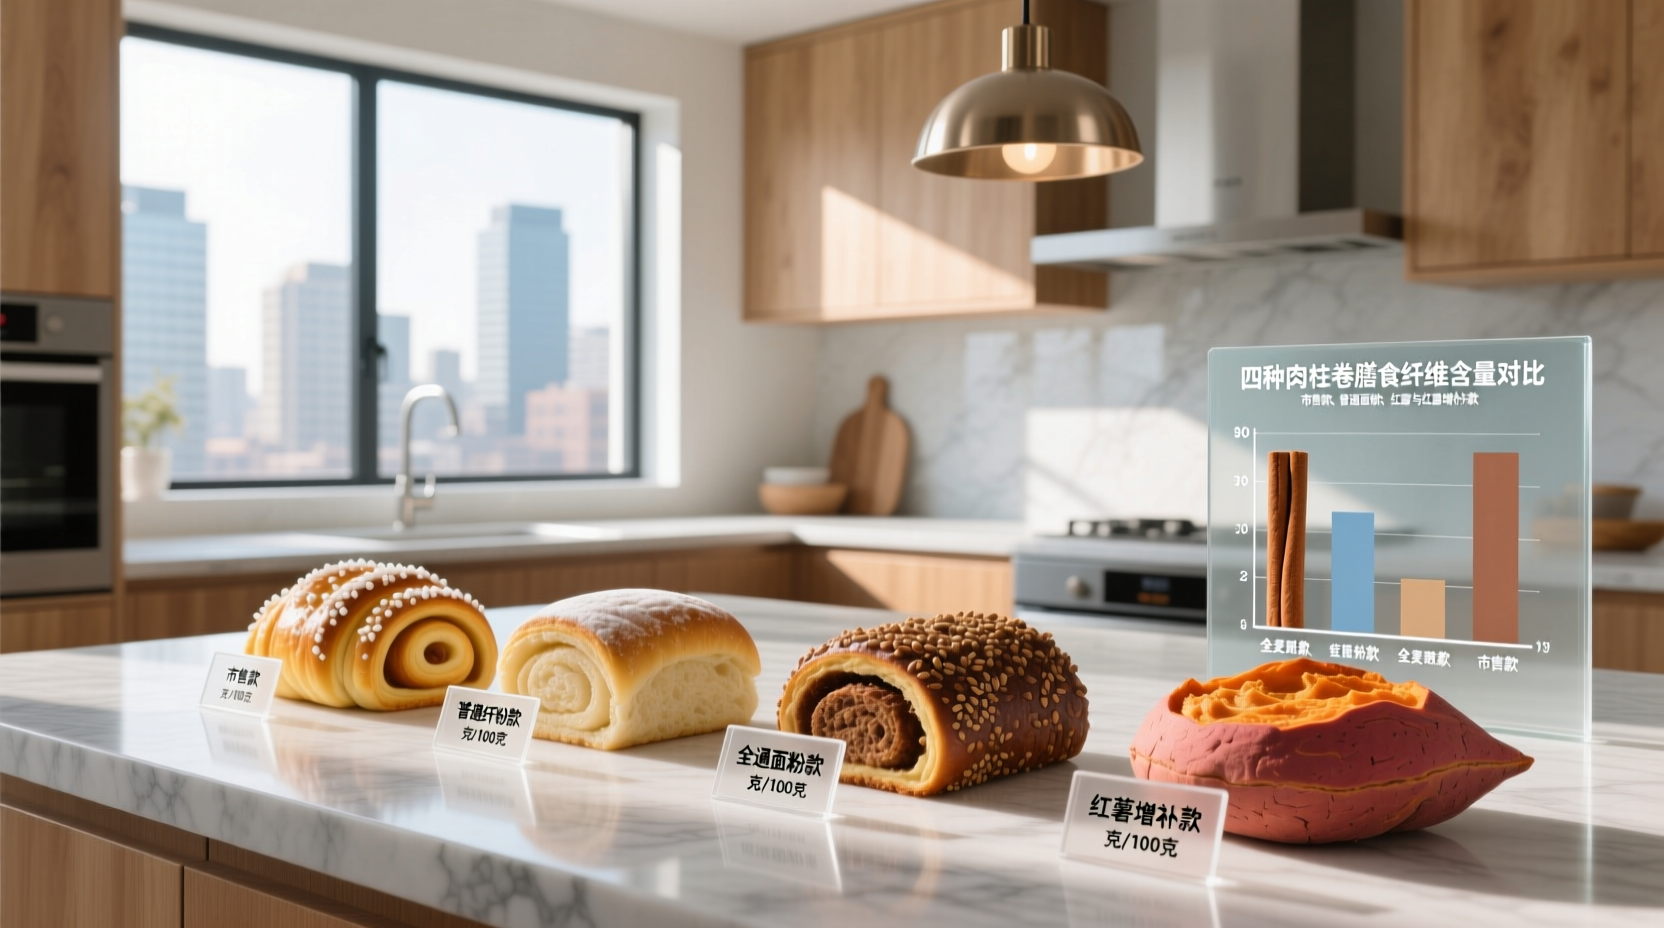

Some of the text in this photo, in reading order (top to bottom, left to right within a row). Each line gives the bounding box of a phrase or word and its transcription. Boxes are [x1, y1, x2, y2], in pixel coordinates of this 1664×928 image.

[747, 774, 807, 799] 克/100克
[1088, 794, 1203, 833] 红薯增补款
[1104, 829, 1179, 858] 克/100克
